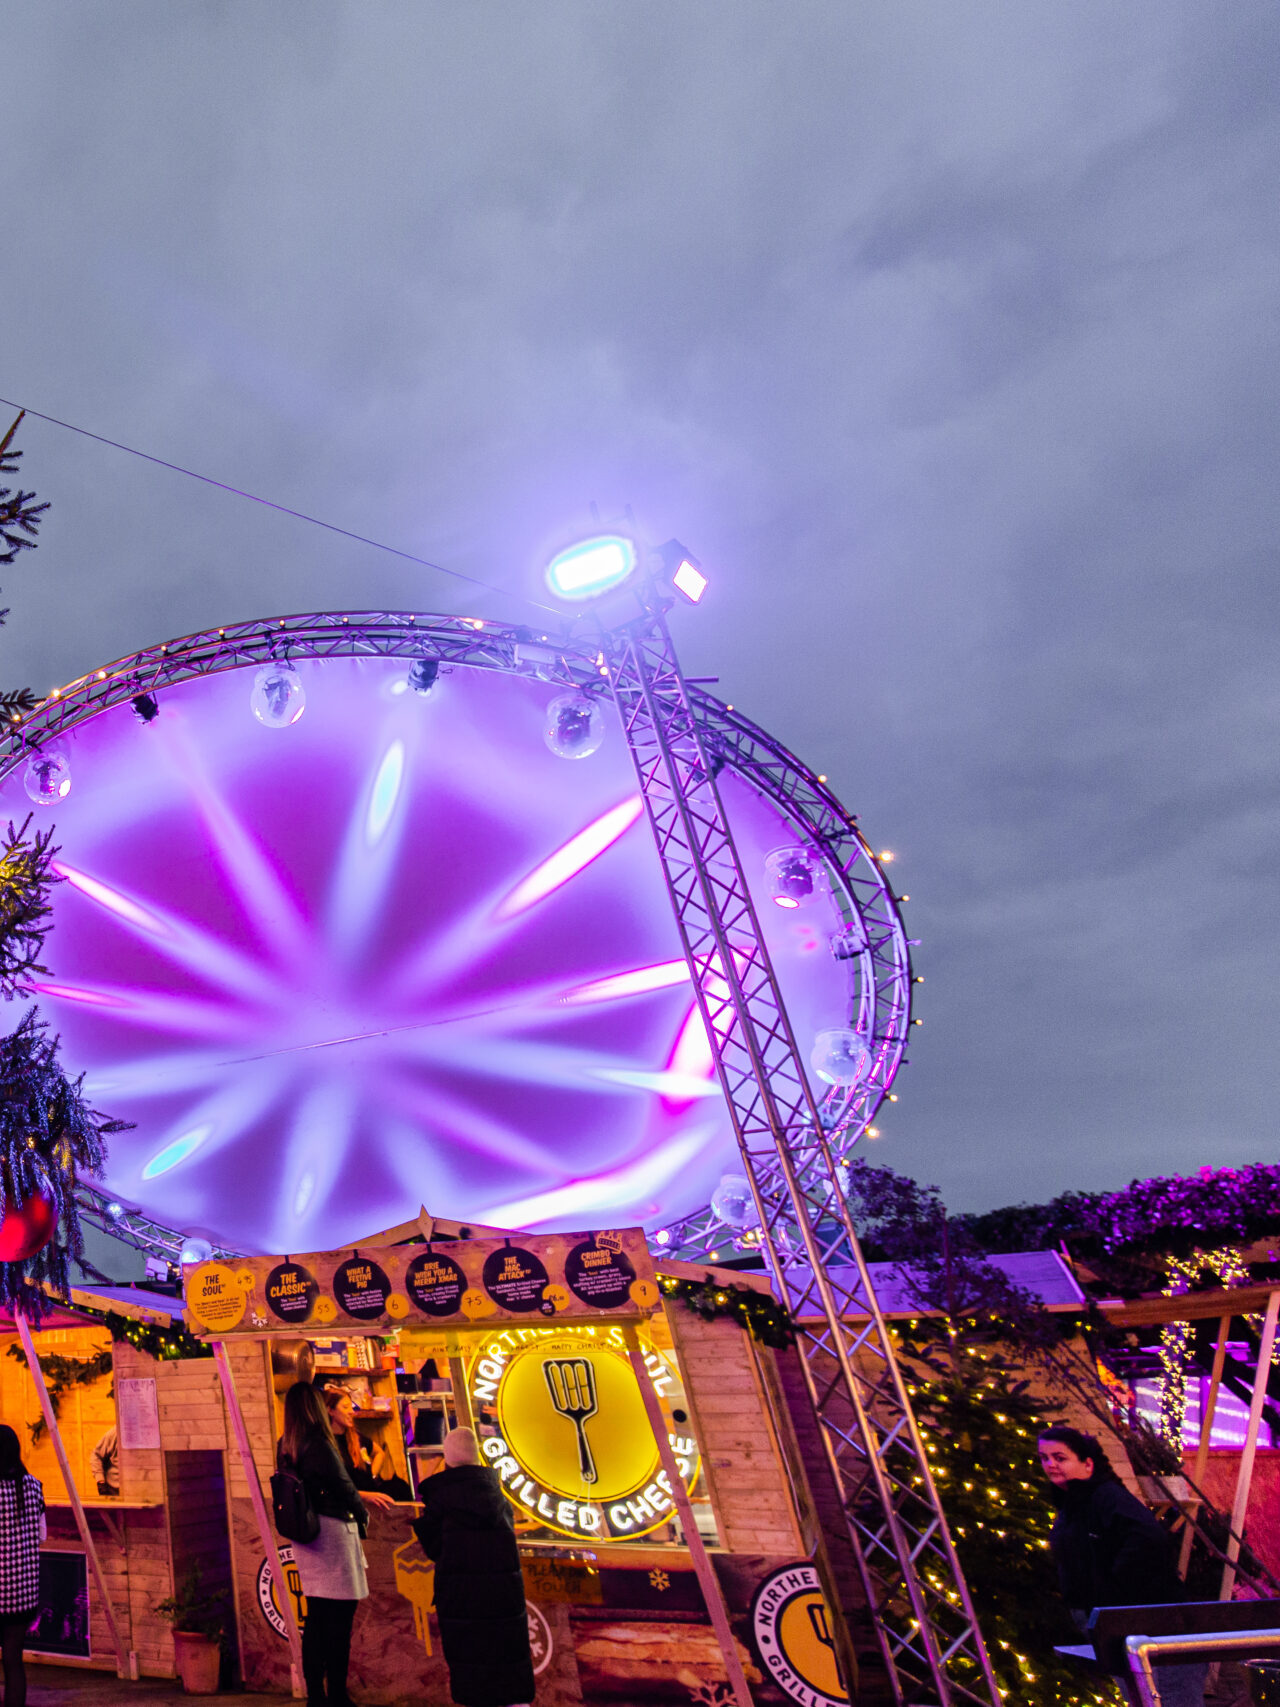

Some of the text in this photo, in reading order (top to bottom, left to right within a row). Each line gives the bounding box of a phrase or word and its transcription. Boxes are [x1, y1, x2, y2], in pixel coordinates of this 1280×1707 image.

[504, 1256, 517, 1264] THE
[581, 1249, 610, 1261] CRIMBO
[505, 1263, 520, 1272] MAC
[584, 1257, 612, 1268] DINNER
[346, 1266, 364, 1276] WHAT
[433, 1268, 446, 1276] YOU
[498, 1270, 525, 1281] ATTACK
[204, 1274, 219, 1285] THE
[280, 1272, 297, 1285] THE
[414, 1273, 458, 1286] MERRY XMAS
[202, 1285, 223, 1296] SOUL
[270, 1282, 307, 1298] CLASSIC
[640, 1285, 647, 1296] 9
[391, 1299, 398, 1310] 6
[483, 1437, 601, 1530] GRILLED
[758, 1571, 814, 1627] NORTHE
[264, 1601, 288, 1634] GRILL
